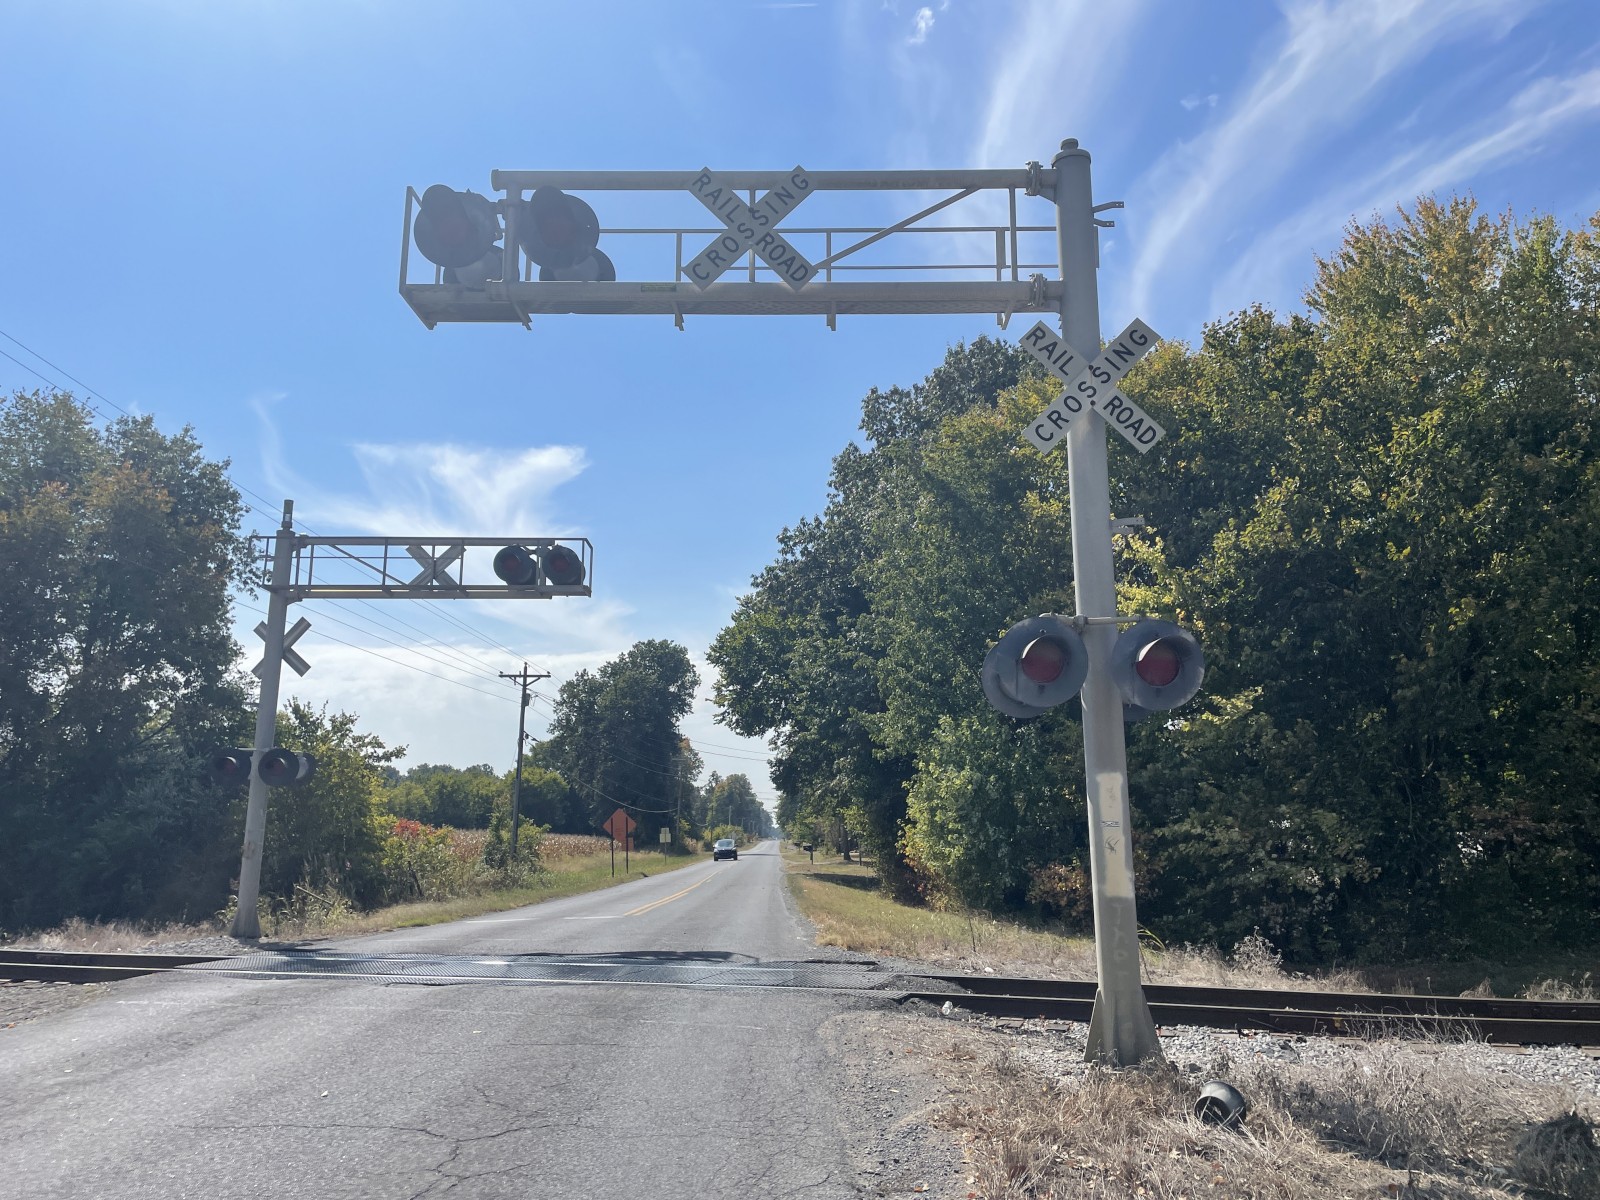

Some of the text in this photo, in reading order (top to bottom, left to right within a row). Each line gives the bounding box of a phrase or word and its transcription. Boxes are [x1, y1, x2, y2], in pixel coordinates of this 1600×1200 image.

[692, 173, 809, 280] CROSSING
[692, 173, 809, 282] RAIL ROAD
[1025, 326, 1157, 445] RAIL ROAD
[1035, 329, 1148, 442] CROSSING
